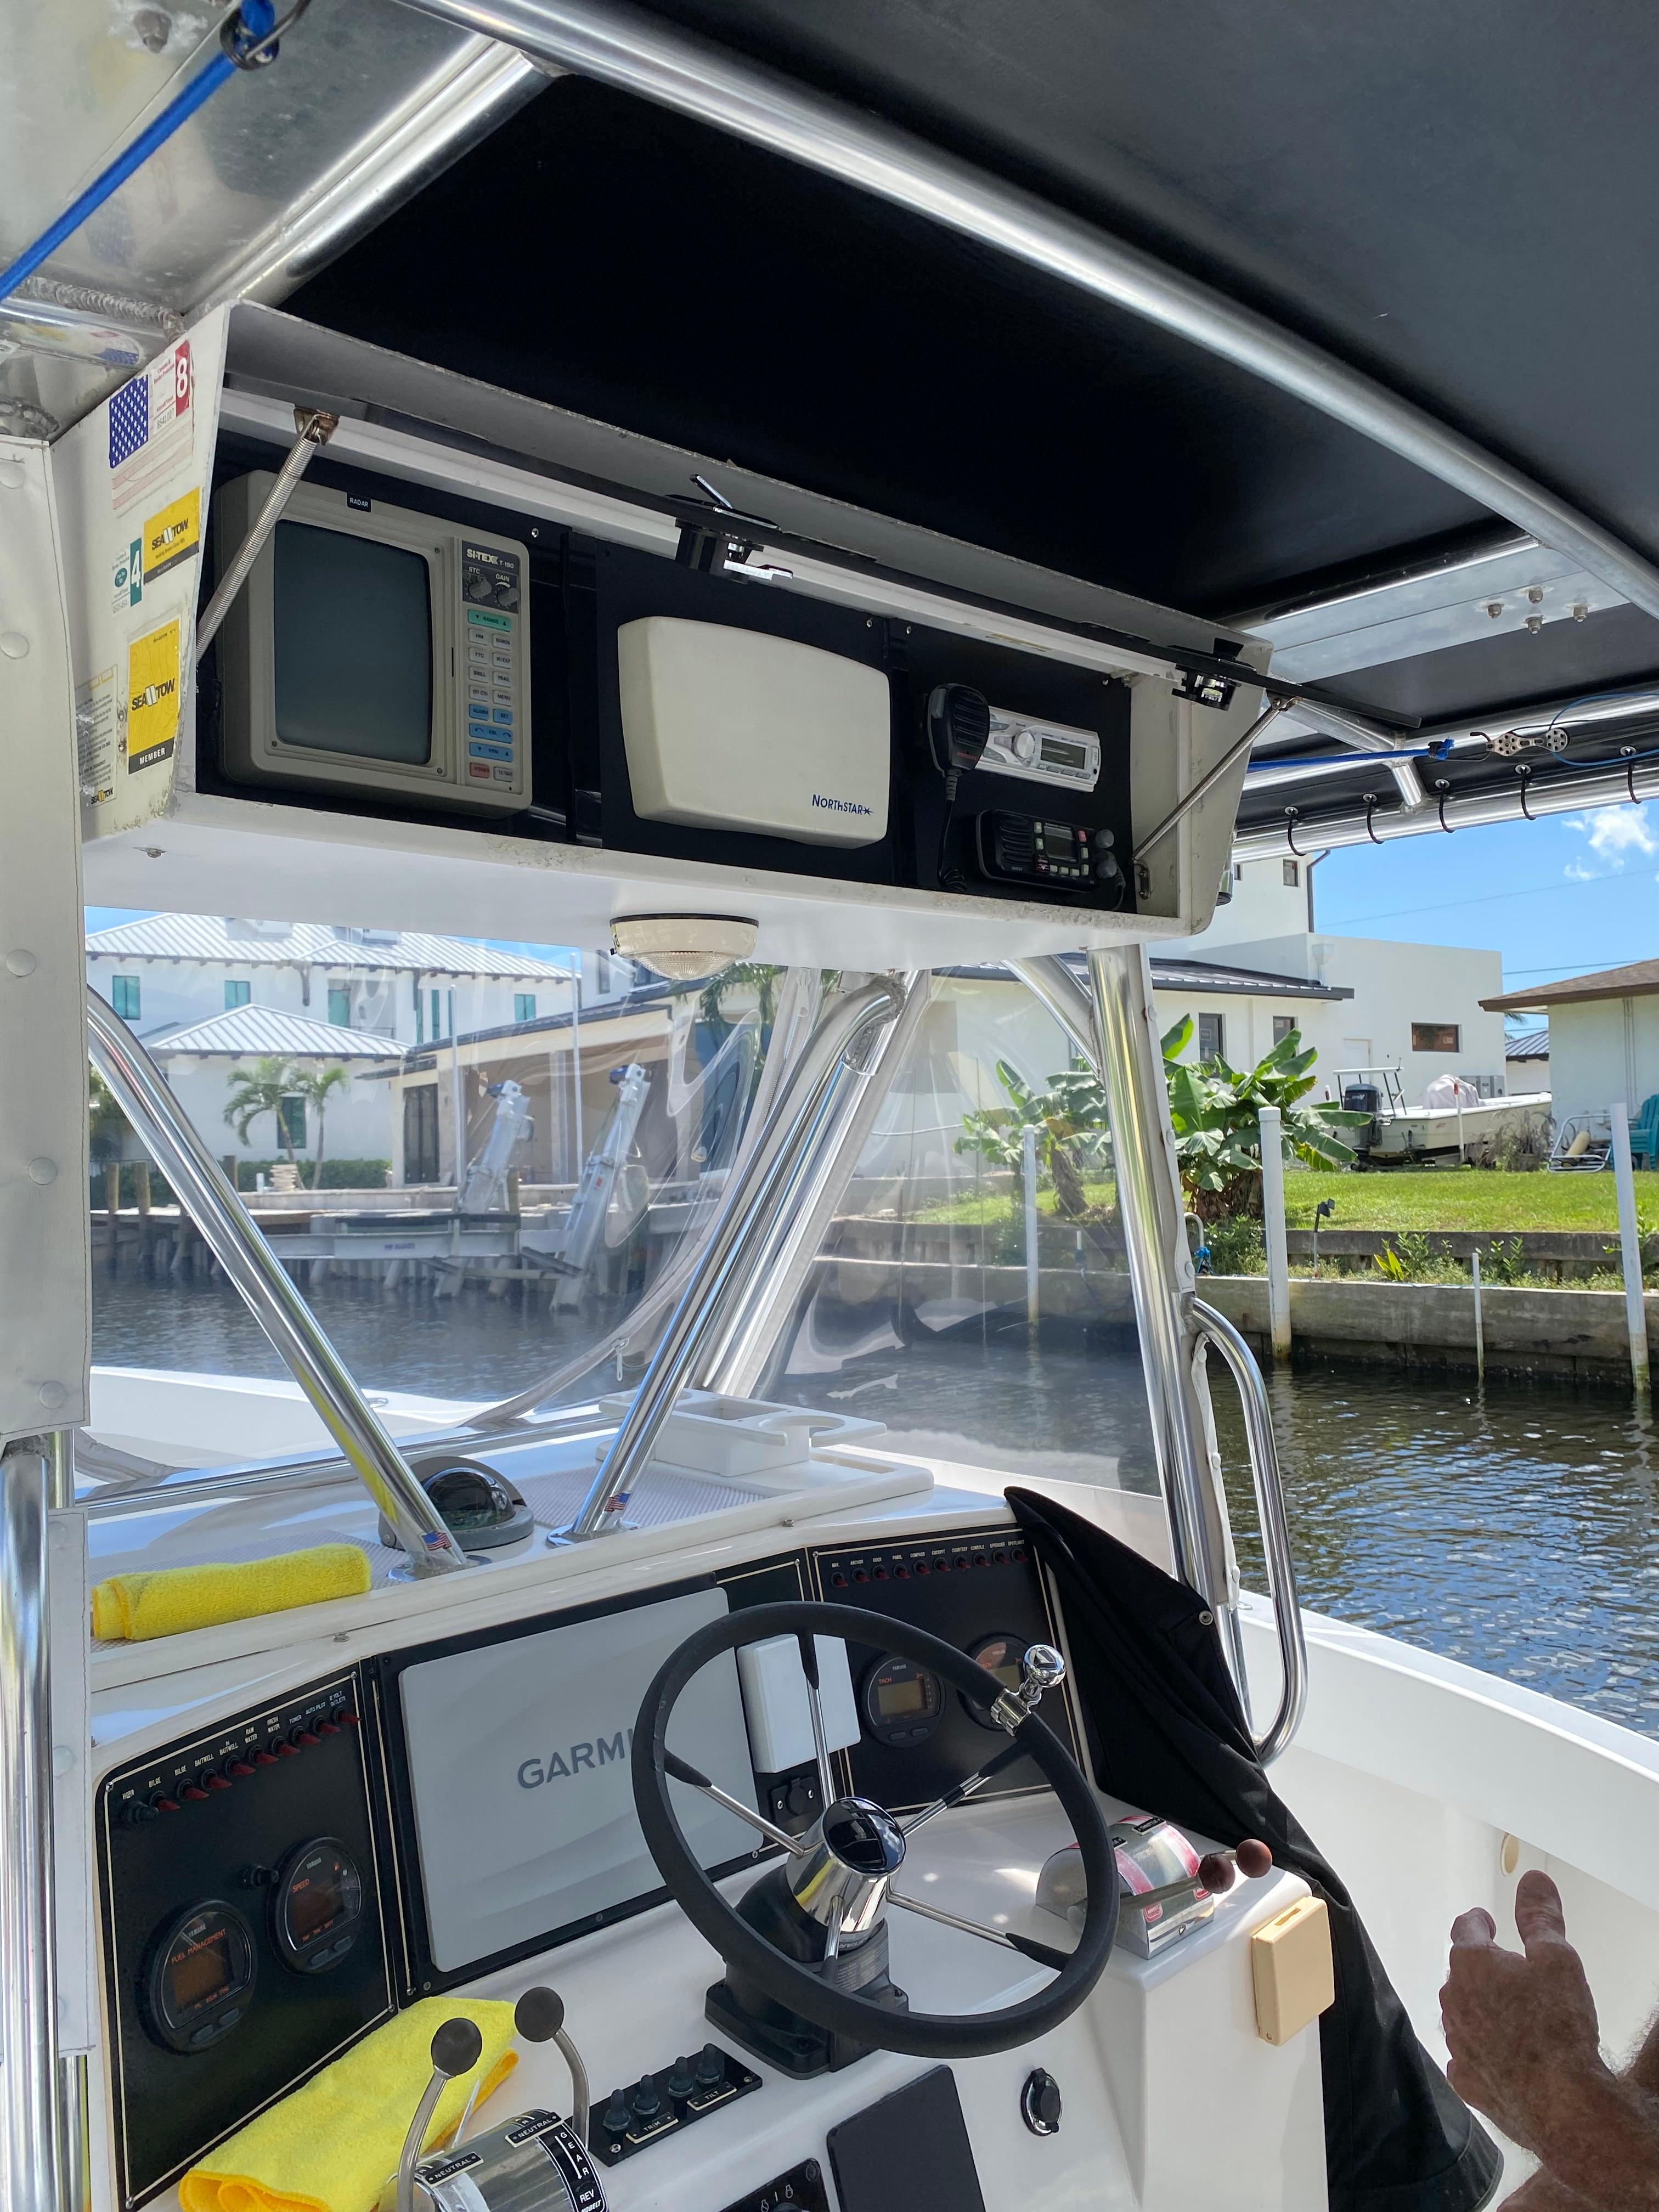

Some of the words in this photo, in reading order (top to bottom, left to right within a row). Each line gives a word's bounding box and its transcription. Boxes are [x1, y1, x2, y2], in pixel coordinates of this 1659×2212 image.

[177, 357, 188, 398] 8
[349, 497, 369, 507] RADAR
[152, 535, 165, 550] SEA
[171, 518, 189, 537] TOW
[131, 550, 140, 588] 4
[132, 692, 147, 710] SEA
[156, 678, 175, 699] TOW
[139, 748, 166, 765] MEMBER
[306, 1706, 315, 1715] AUTO
[316, 1701, 326, 1710] PILOT
[267, 1716, 279, 1726] FRESH
[289, 1714, 302, 1724] TOWER
[245, 1726, 255, 1736] RAW
[267, 1723, 281, 1733] WATER
[245, 1733, 258, 1743] WATER
[219, 1742, 239, 1756] BAITWELL
[194, 1753, 215, 1767] BAITWELL
[517, 1728, 633, 1788] GARMI
[174, 1765, 187, 1776] BILGE
[148, 1776, 161, 1788] BILGE
[122, 1789, 134, 1800] HORN
[306, 1857, 321, 1870] YAMAHA
[292, 1878, 310, 1893] SPEED
[188, 1923, 206, 1938] YAMAHA
[171, 1953, 186, 1965] FUEL
[188, 1928, 227, 1955] MANAGEMENT
[704, 2090, 719, 2100] TILT
[517, 2118, 552, 2138] NEUTRAL
[643, 2120, 661, 2132] TRIM
[560, 2131, 590, 2176] GEAR
[434, 2158, 472, 2180] NEUTRAL
[579, 2189, 594, 2203] REV
